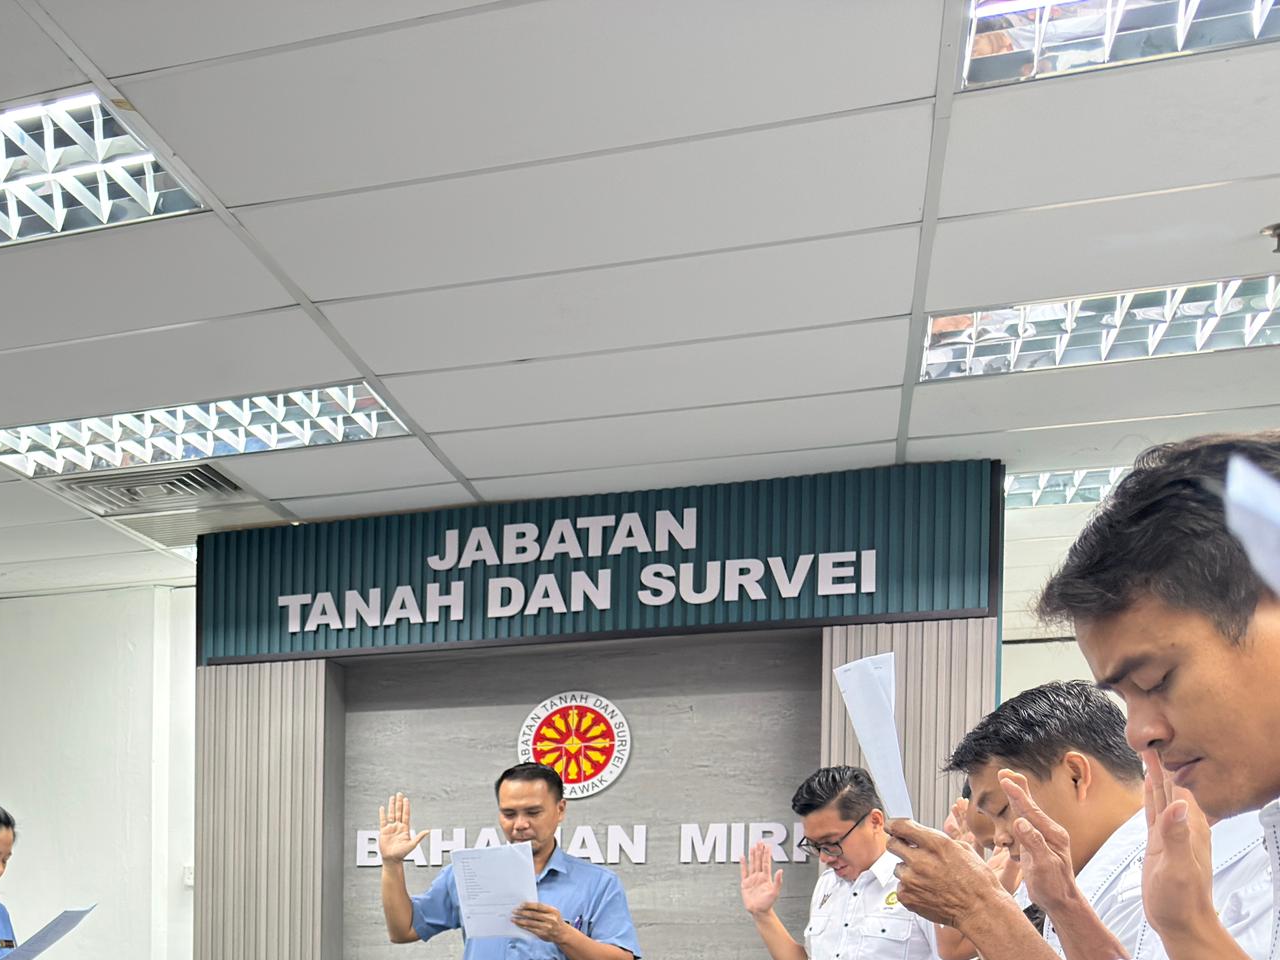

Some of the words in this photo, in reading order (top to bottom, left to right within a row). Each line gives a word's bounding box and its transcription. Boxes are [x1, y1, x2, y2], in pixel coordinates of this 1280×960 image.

[427, 508, 697, 571] JABATAN
[278, 581, 464, 633] TANAH
[487, 568, 611, 618] DAN
[637, 550, 876, 606] SURVEI
[541, 694, 588, 712] TANAH
[593, 698, 618, 720] DAN
[612, 721, 627, 769] SURVEI
